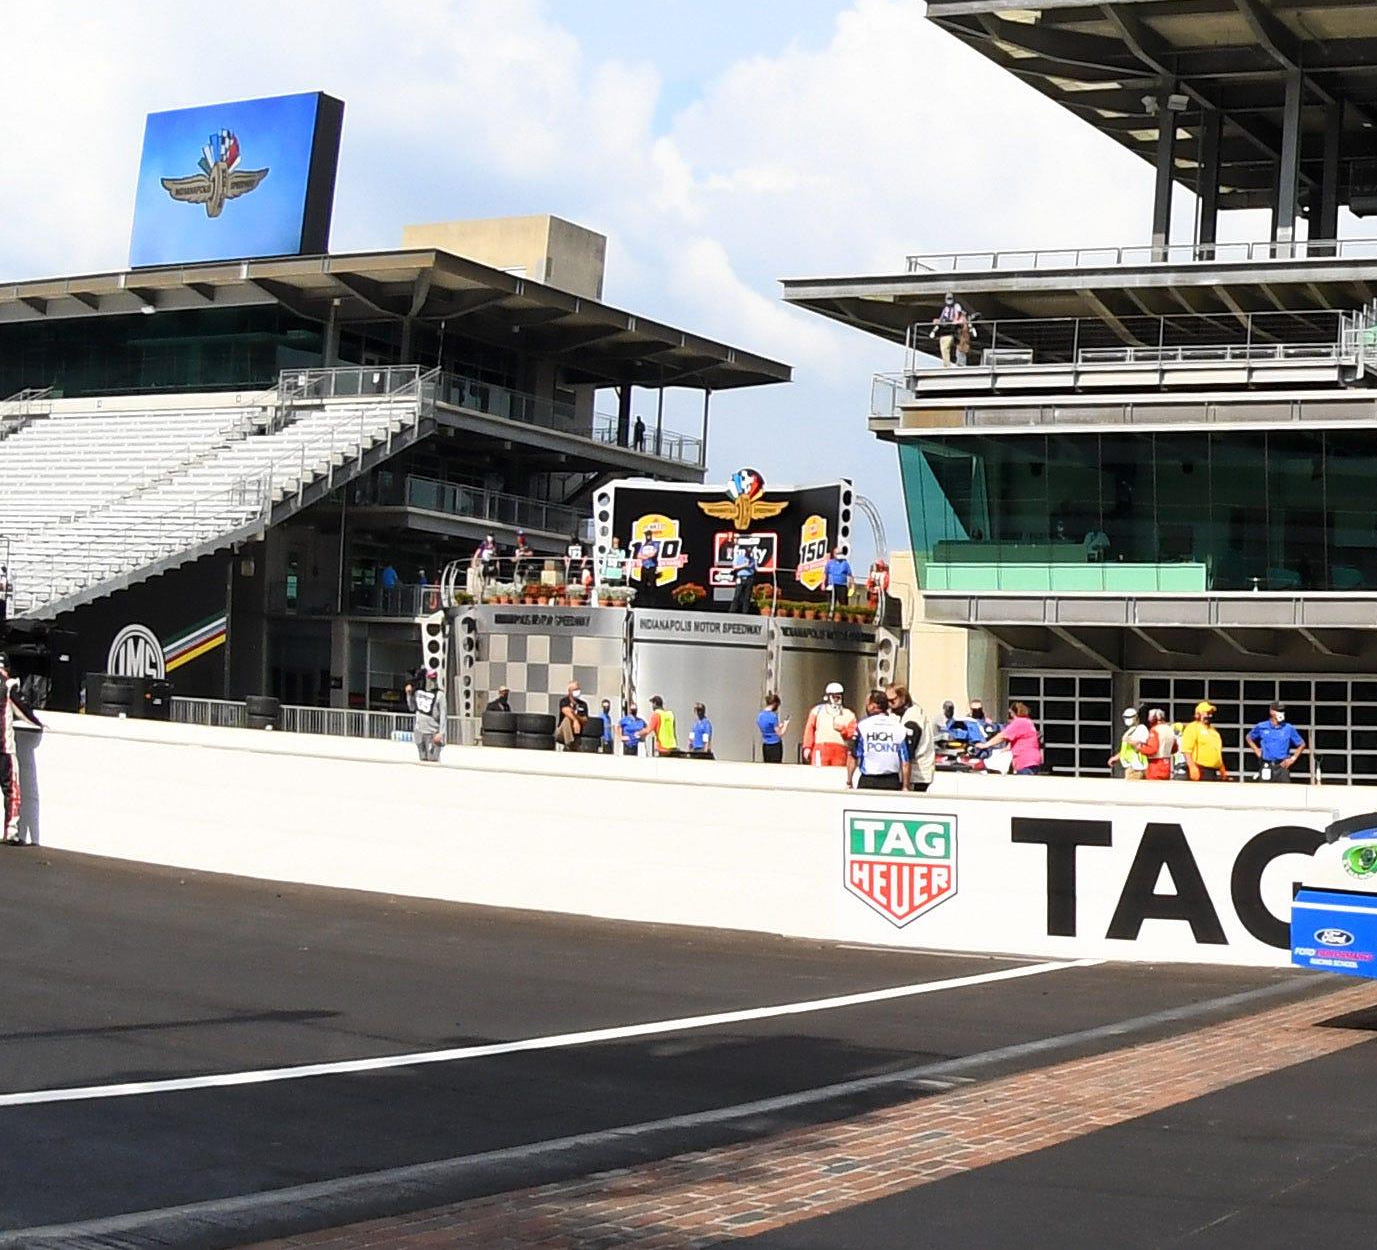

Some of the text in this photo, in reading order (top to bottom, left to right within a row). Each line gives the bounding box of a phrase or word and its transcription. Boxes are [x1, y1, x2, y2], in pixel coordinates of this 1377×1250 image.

[632, 541, 680, 559] 10
[801, 540, 826, 564] 150
[639, 618, 763, 636] INDIANAPOLIS MOTOR SPEEDWAY
[866, 732, 894, 742] HIGH
[866, 742, 900, 753] POINT
[853, 820, 946, 857] TAG
[849, 862, 950, 909] HEUER
